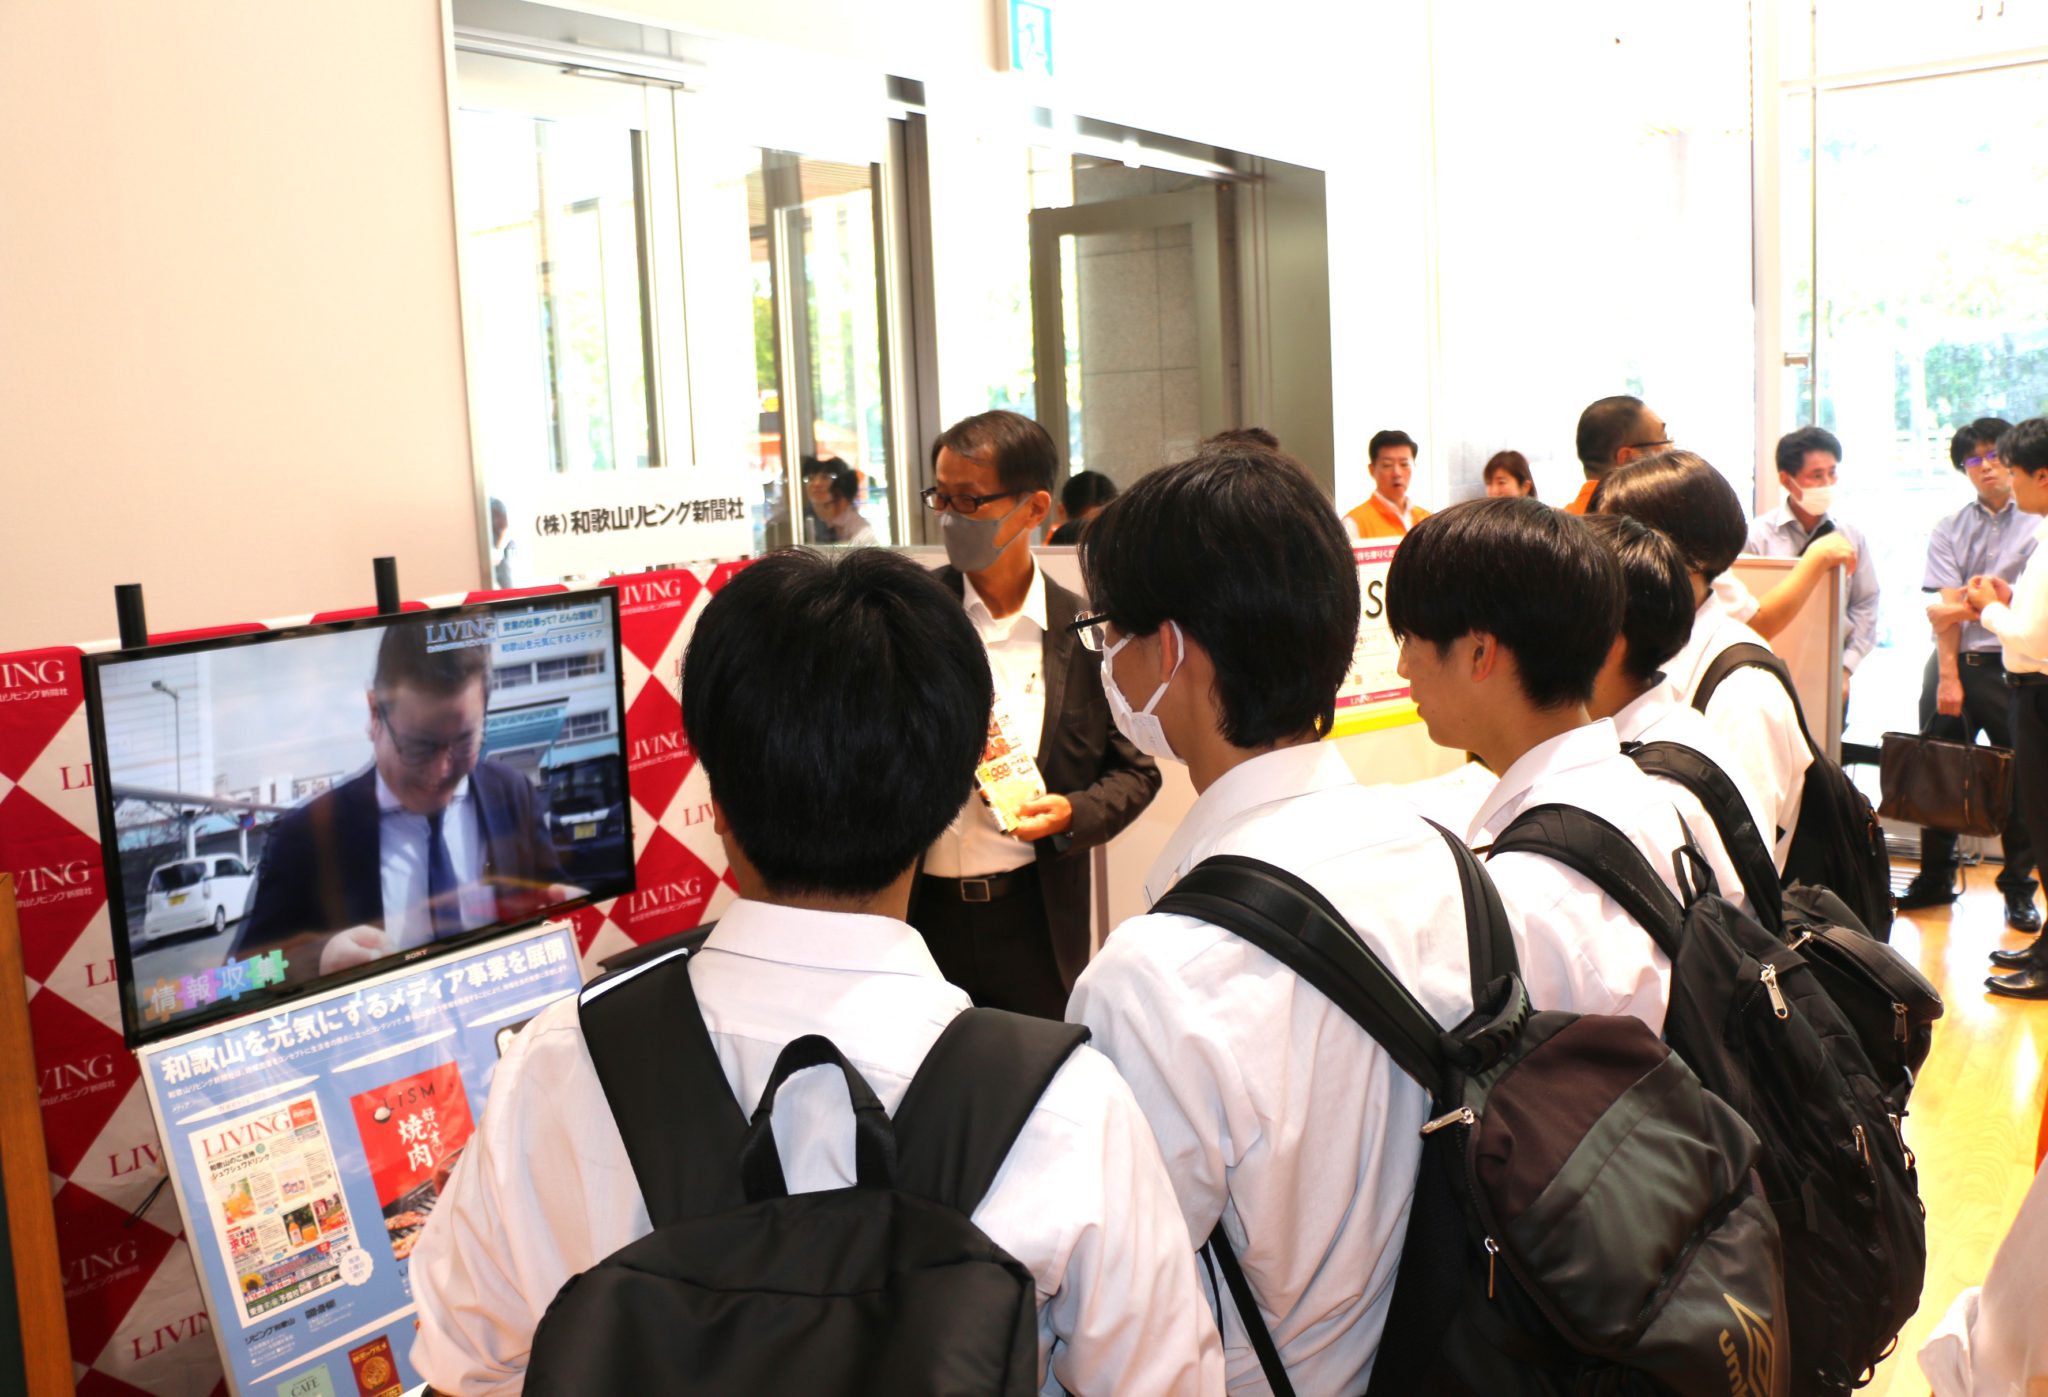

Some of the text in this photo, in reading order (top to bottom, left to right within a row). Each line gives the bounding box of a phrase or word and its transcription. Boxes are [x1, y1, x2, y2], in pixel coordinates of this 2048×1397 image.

[1, 659, 66, 688] ING
[629, 877, 701, 914] LIVING
[404, 948, 428, 961] SONY
[150, 956, 275, 1014] 情報収集
[161, 937, 567, 1085] 和歌山を元気にするメディア事業を展開
[202, 1115, 291, 1158] LIVING
[398, 1113, 434, 1172] 焼肉
